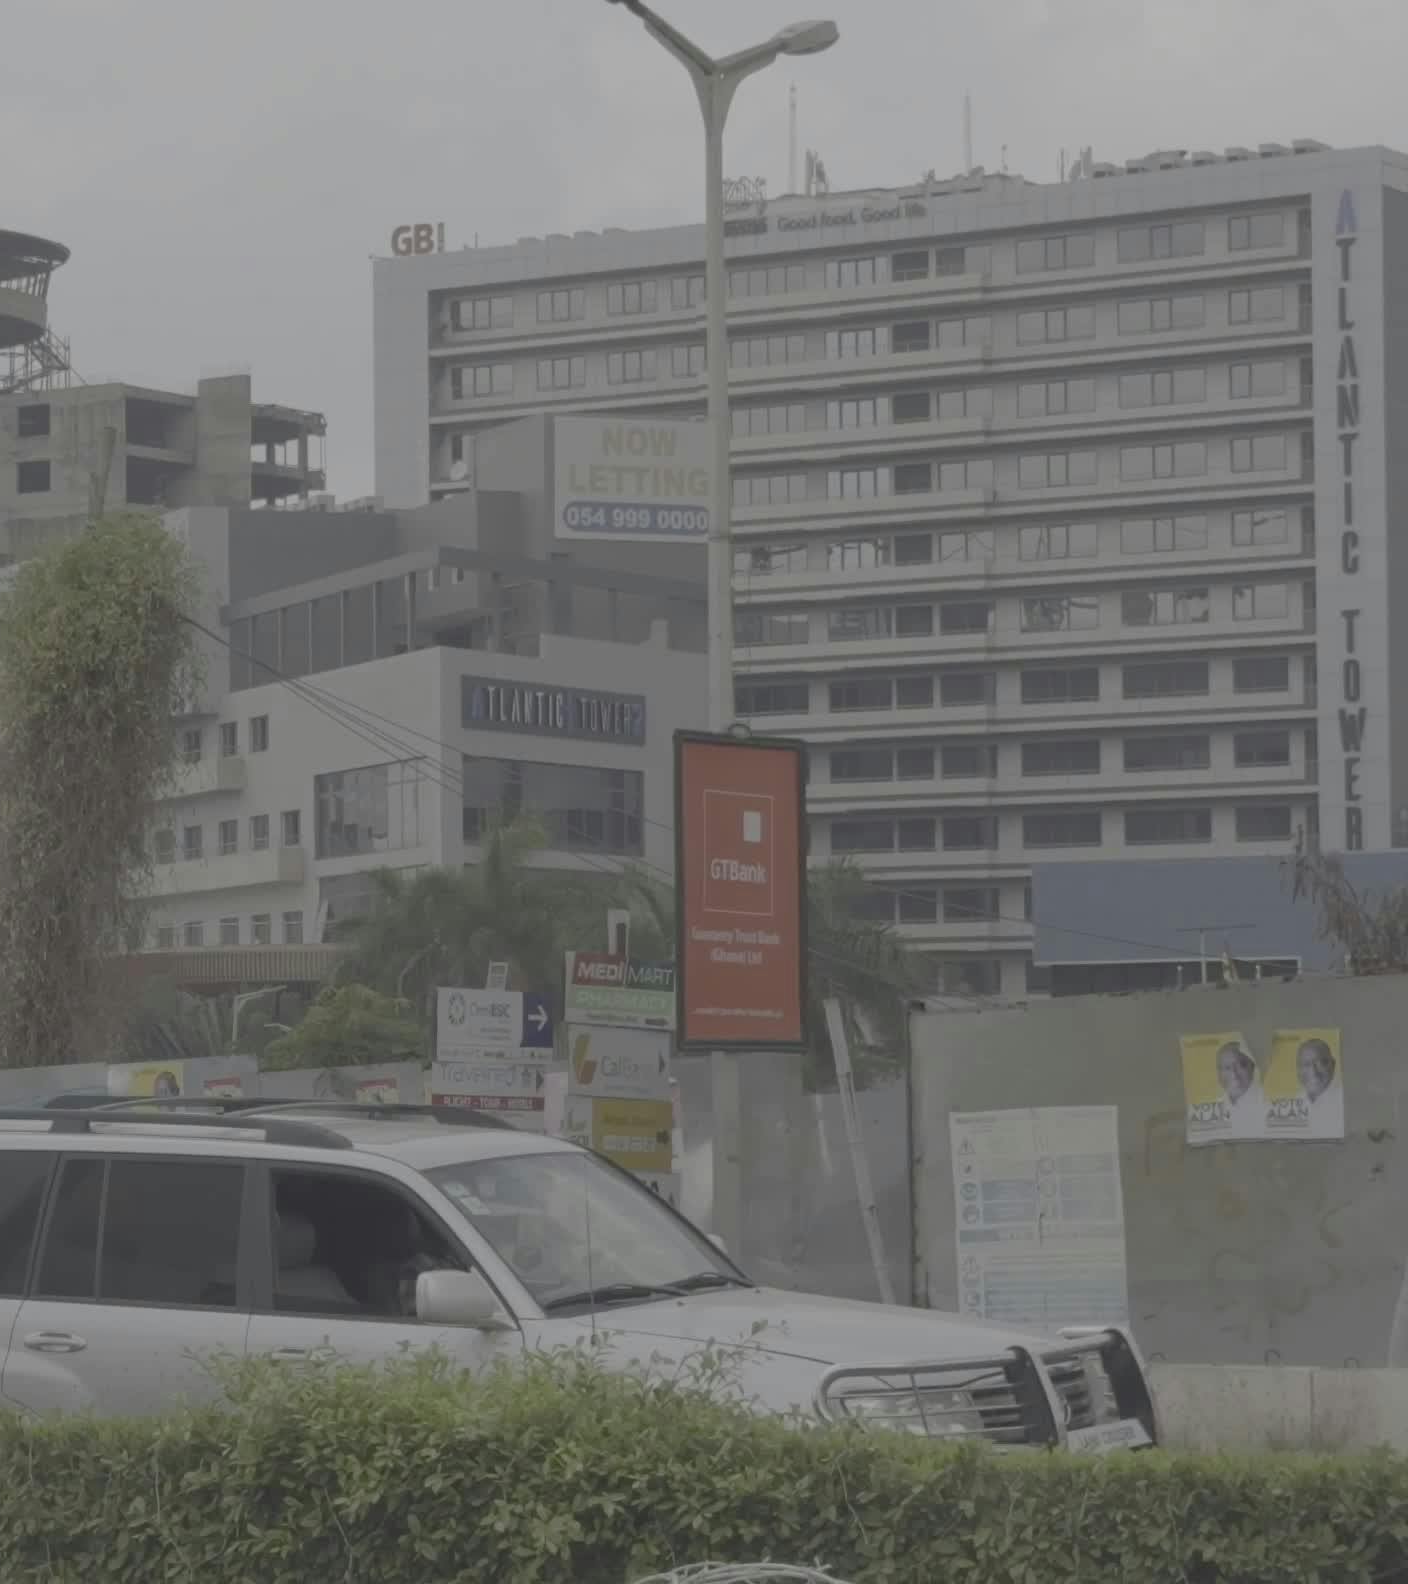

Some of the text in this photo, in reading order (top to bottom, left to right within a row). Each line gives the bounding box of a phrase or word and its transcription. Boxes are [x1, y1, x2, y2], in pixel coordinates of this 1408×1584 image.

[602, 424, 677, 456] NOW
[568, 464, 709, 496] LETTING
[567, 506, 708, 530] 054 999 0000
[1335, 189, 1367, 851] ATLANTIC TOWER
[471, 682, 563, 729] ATLANTIC
[710, 857, 767, 885] GTBank
[627, 965, 673, 985] MART
